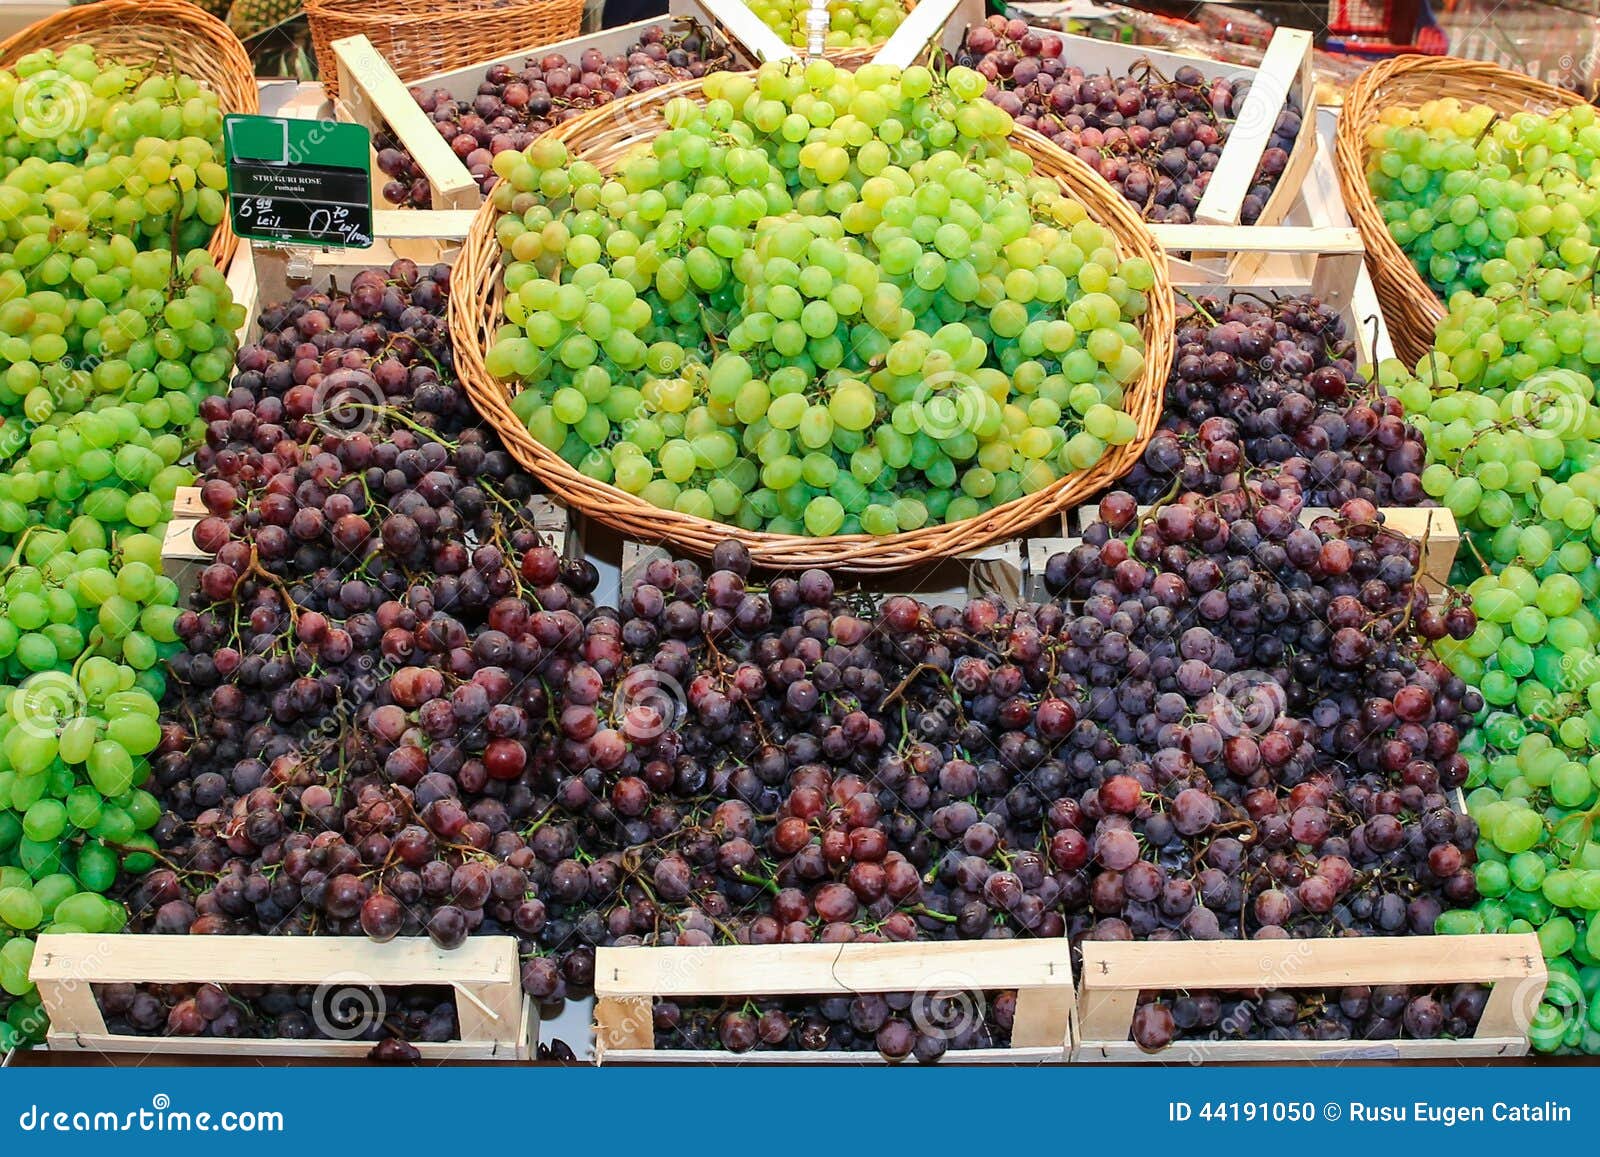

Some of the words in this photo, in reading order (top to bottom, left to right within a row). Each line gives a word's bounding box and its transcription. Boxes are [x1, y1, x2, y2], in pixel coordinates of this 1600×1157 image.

[252, 174, 297, 184] STRUGURI
[298, 176, 322, 185] ROSE
[274, 184, 305, 193] romania
[240, 198, 253, 218] 6
